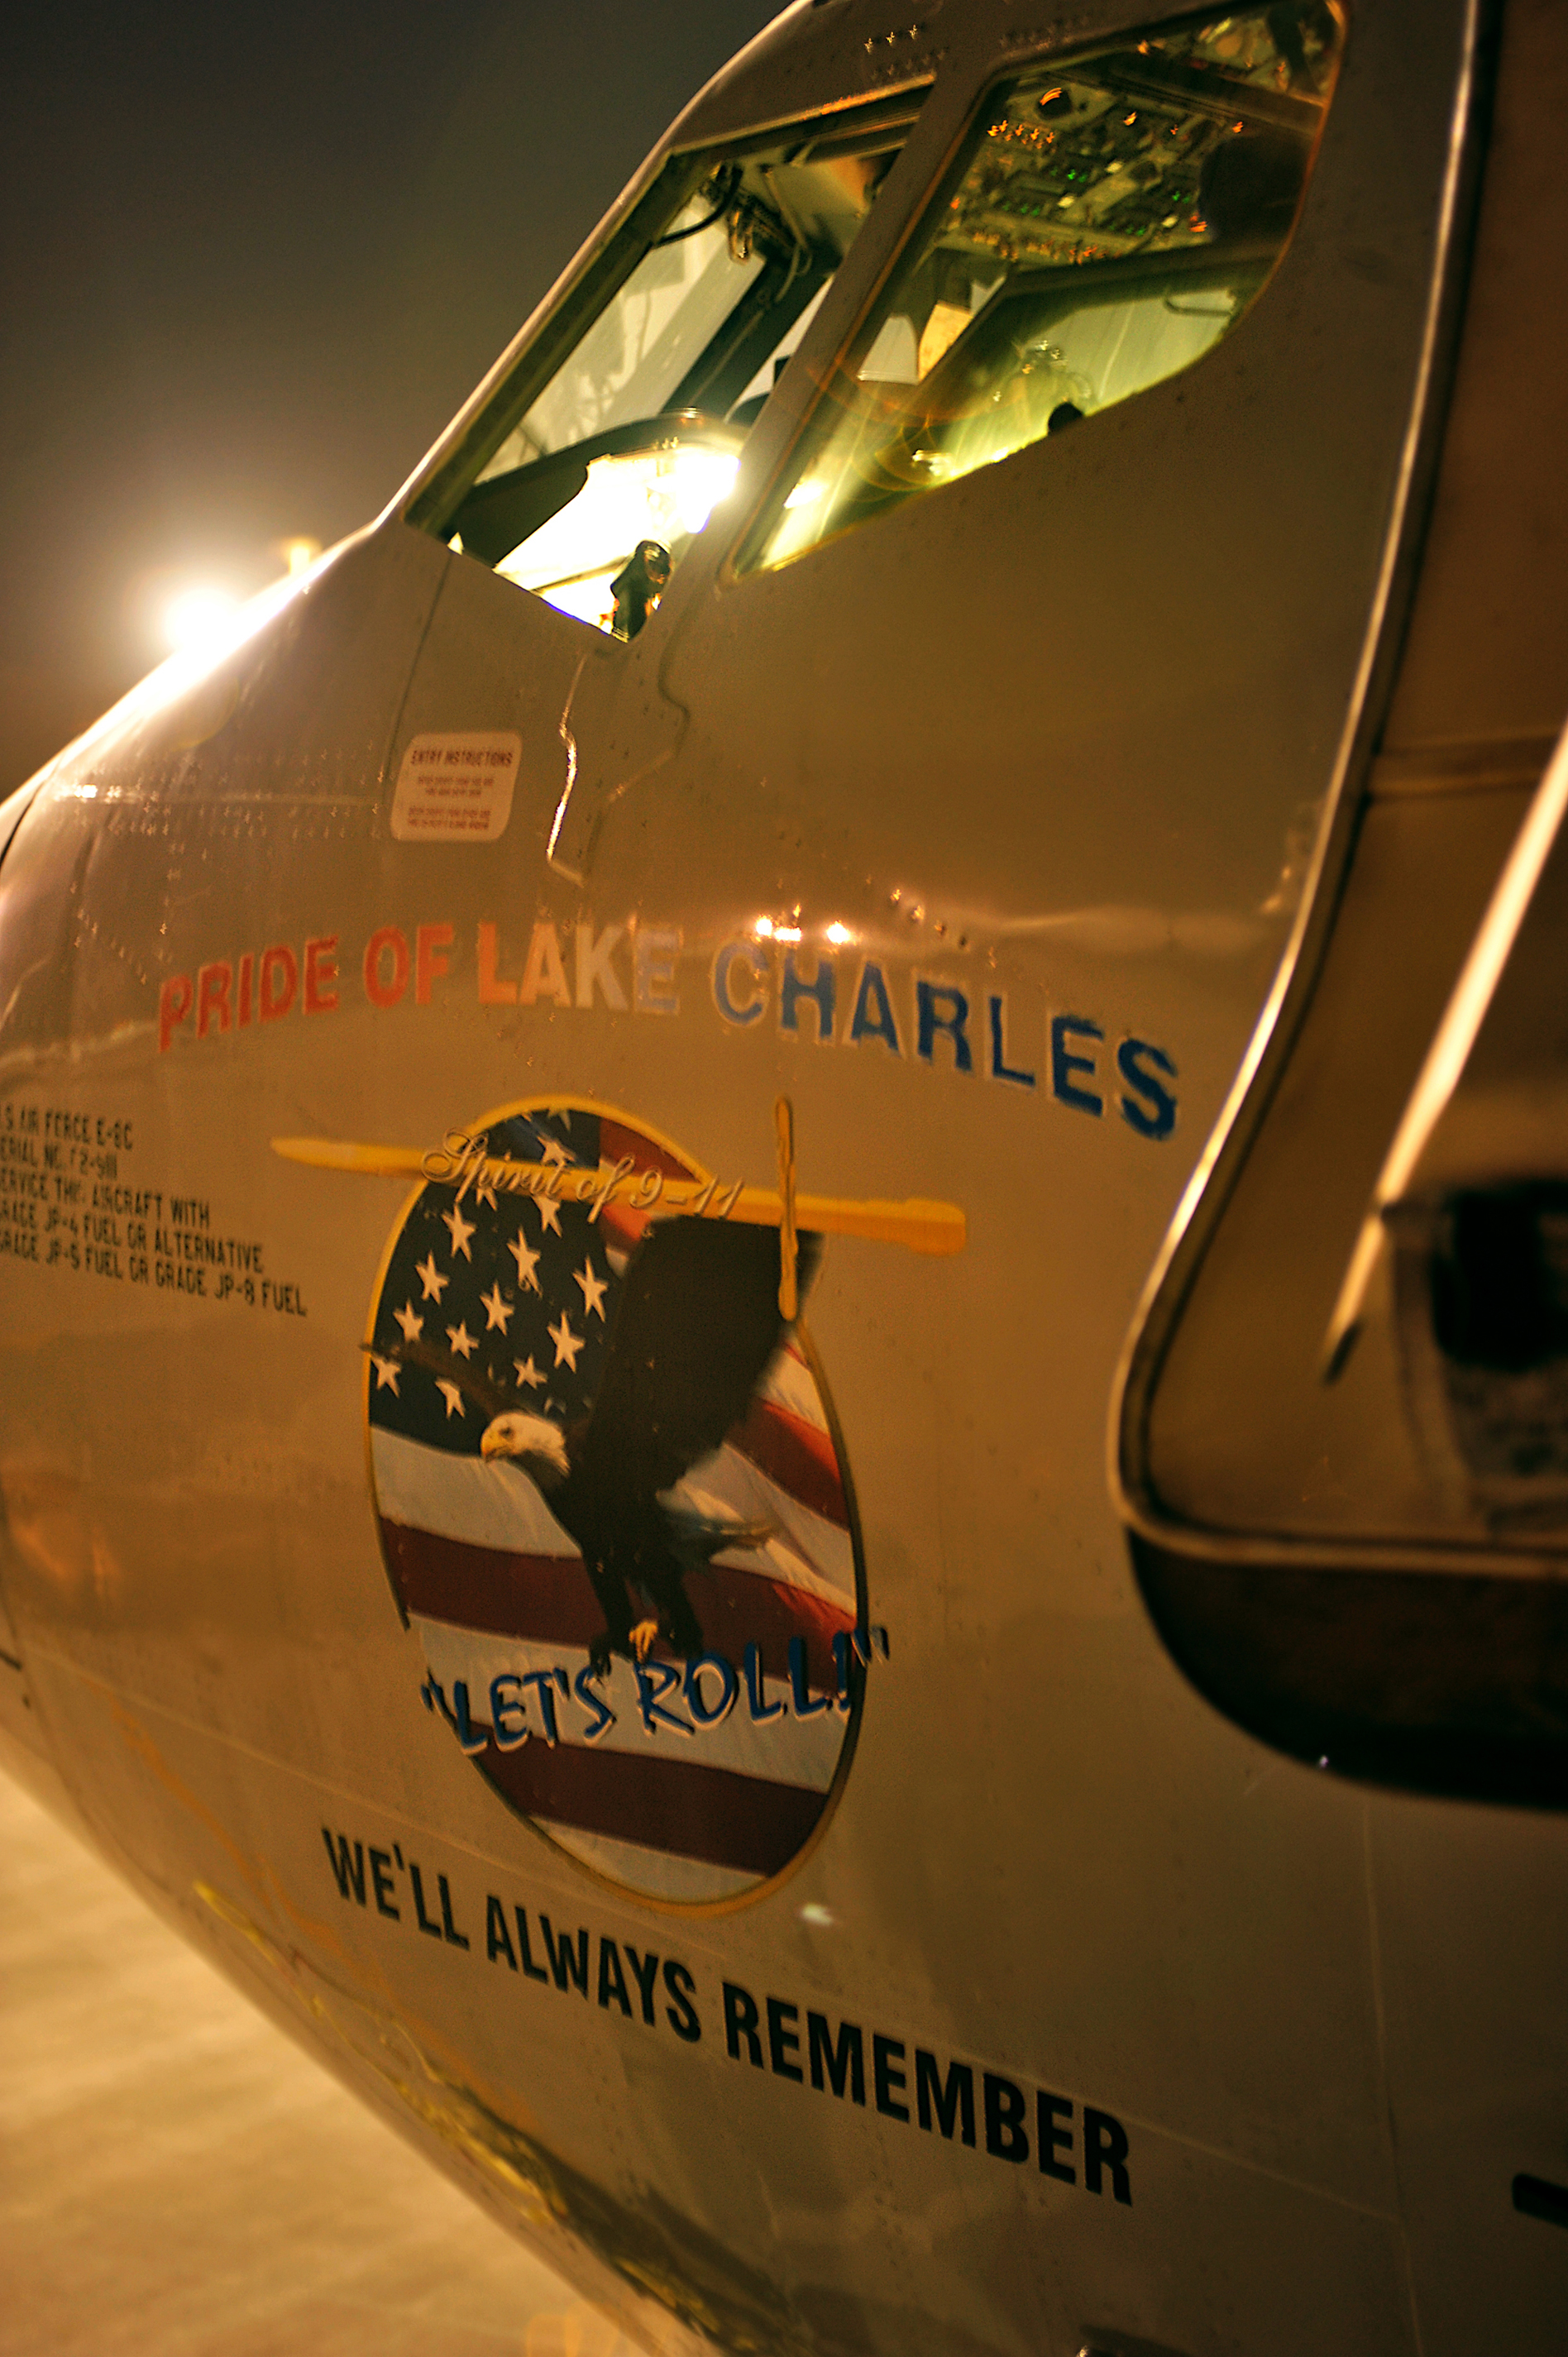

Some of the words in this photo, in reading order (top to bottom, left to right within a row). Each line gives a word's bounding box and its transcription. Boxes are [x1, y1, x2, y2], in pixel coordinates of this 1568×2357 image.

[157, 935, 339, 1053] PRIDE
[364, 924, 454, 1007] OF
[477, 918, 683, 1016] LAKE
[711, 933, 1178, 1141] CHARLES
[44, 1107, 91, 1145] FORCE
[92, 1183, 163, 1221] AIRCRAFT
[170, 1196, 210, 1230] WITH
[420, 1127, 571, 1204] Spirit
[576, 1154, 635, 1224] of
[629, 1167, 743, 1220] 9-11
[84, 1212, 120, 1247] FUEL
[127, 1221, 147, 1252] OR
[154, 1228, 264, 1274] ALTERNATIVE
[85, 1243, 123, 1280] FUEL
[128, 1255, 149, 1284] OR
[155, 1260, 207, 1298] GRADE
[261, 1278, 308, 1317] FUEL
[321, 1826, 471, 1953] WE'LL
[486, 1893, 702, 2044] ALWAYS
[722, 1980, 1133, 2207] REMEMBER
